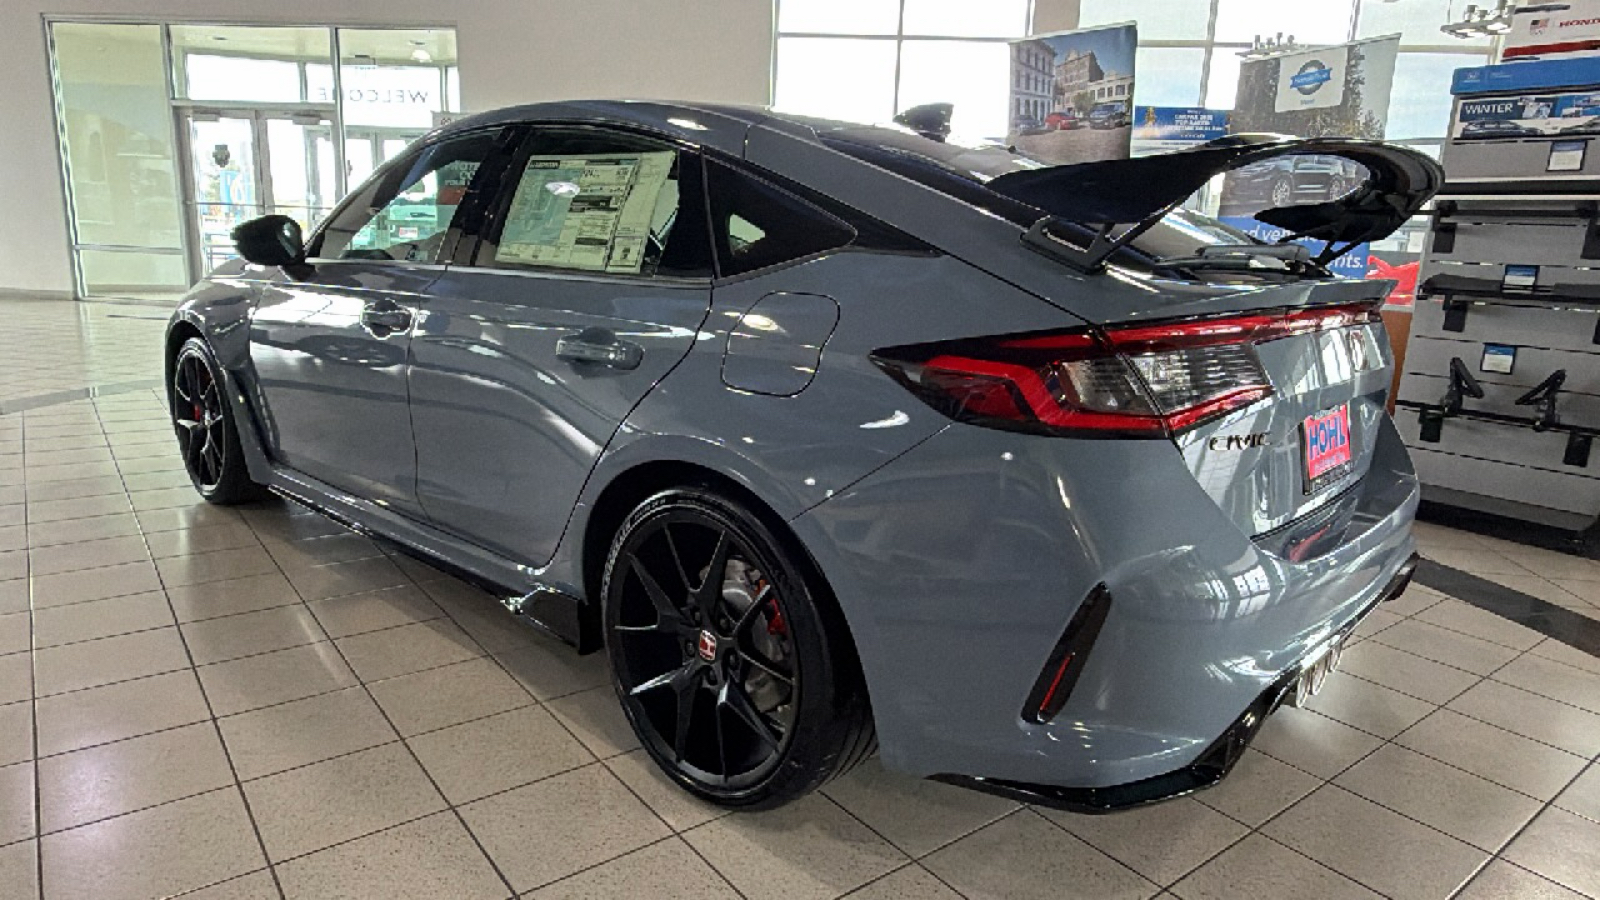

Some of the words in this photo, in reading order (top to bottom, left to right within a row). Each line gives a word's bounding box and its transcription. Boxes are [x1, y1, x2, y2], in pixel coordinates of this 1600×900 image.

[1465, 103, 1513, 115] WINTER
[1209, 432, 1271, 451] CIVIC
[1309, 415, 1345, 459] HOHL
